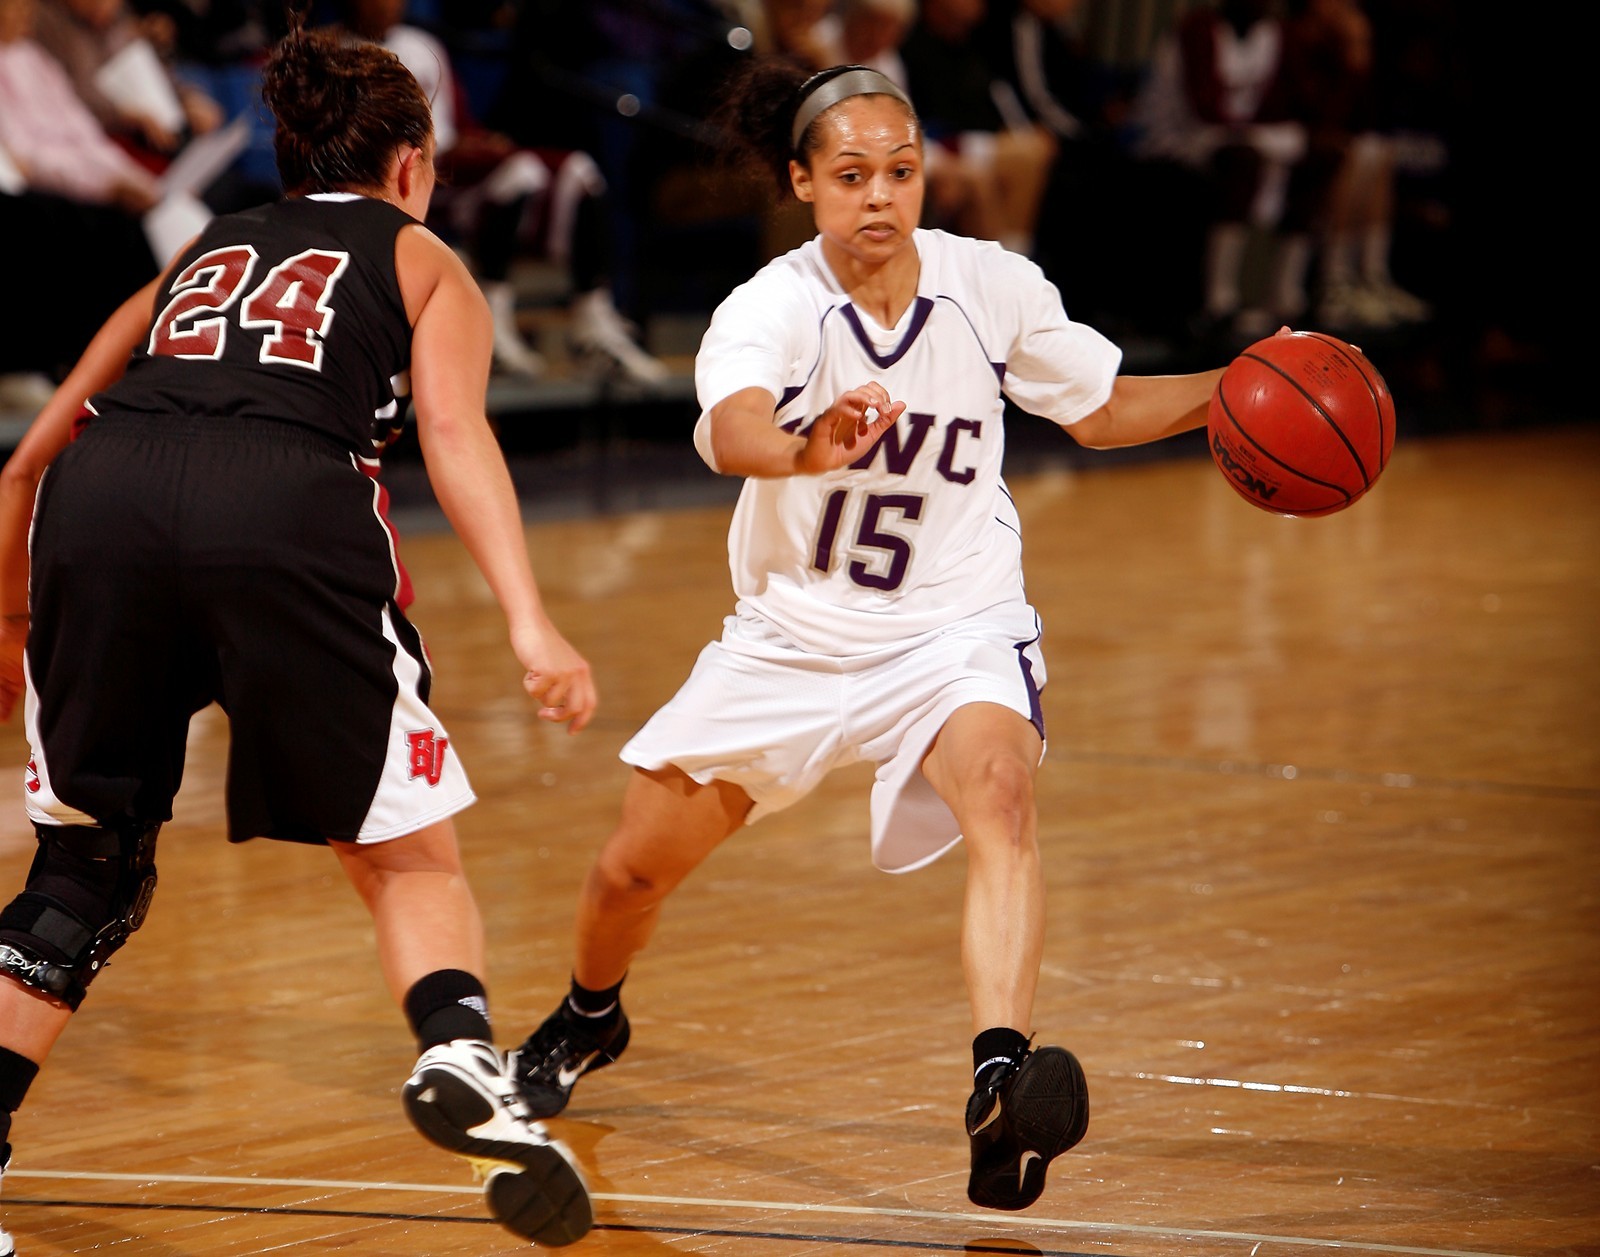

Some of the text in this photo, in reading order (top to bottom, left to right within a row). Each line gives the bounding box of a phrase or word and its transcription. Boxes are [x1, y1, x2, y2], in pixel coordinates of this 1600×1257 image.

[147, 244, 350, 372] 24
[780, 412, 982, 486] WC
[1213, 431, 1280, 501] NCAA
[808, 487, 929, 596] 15
